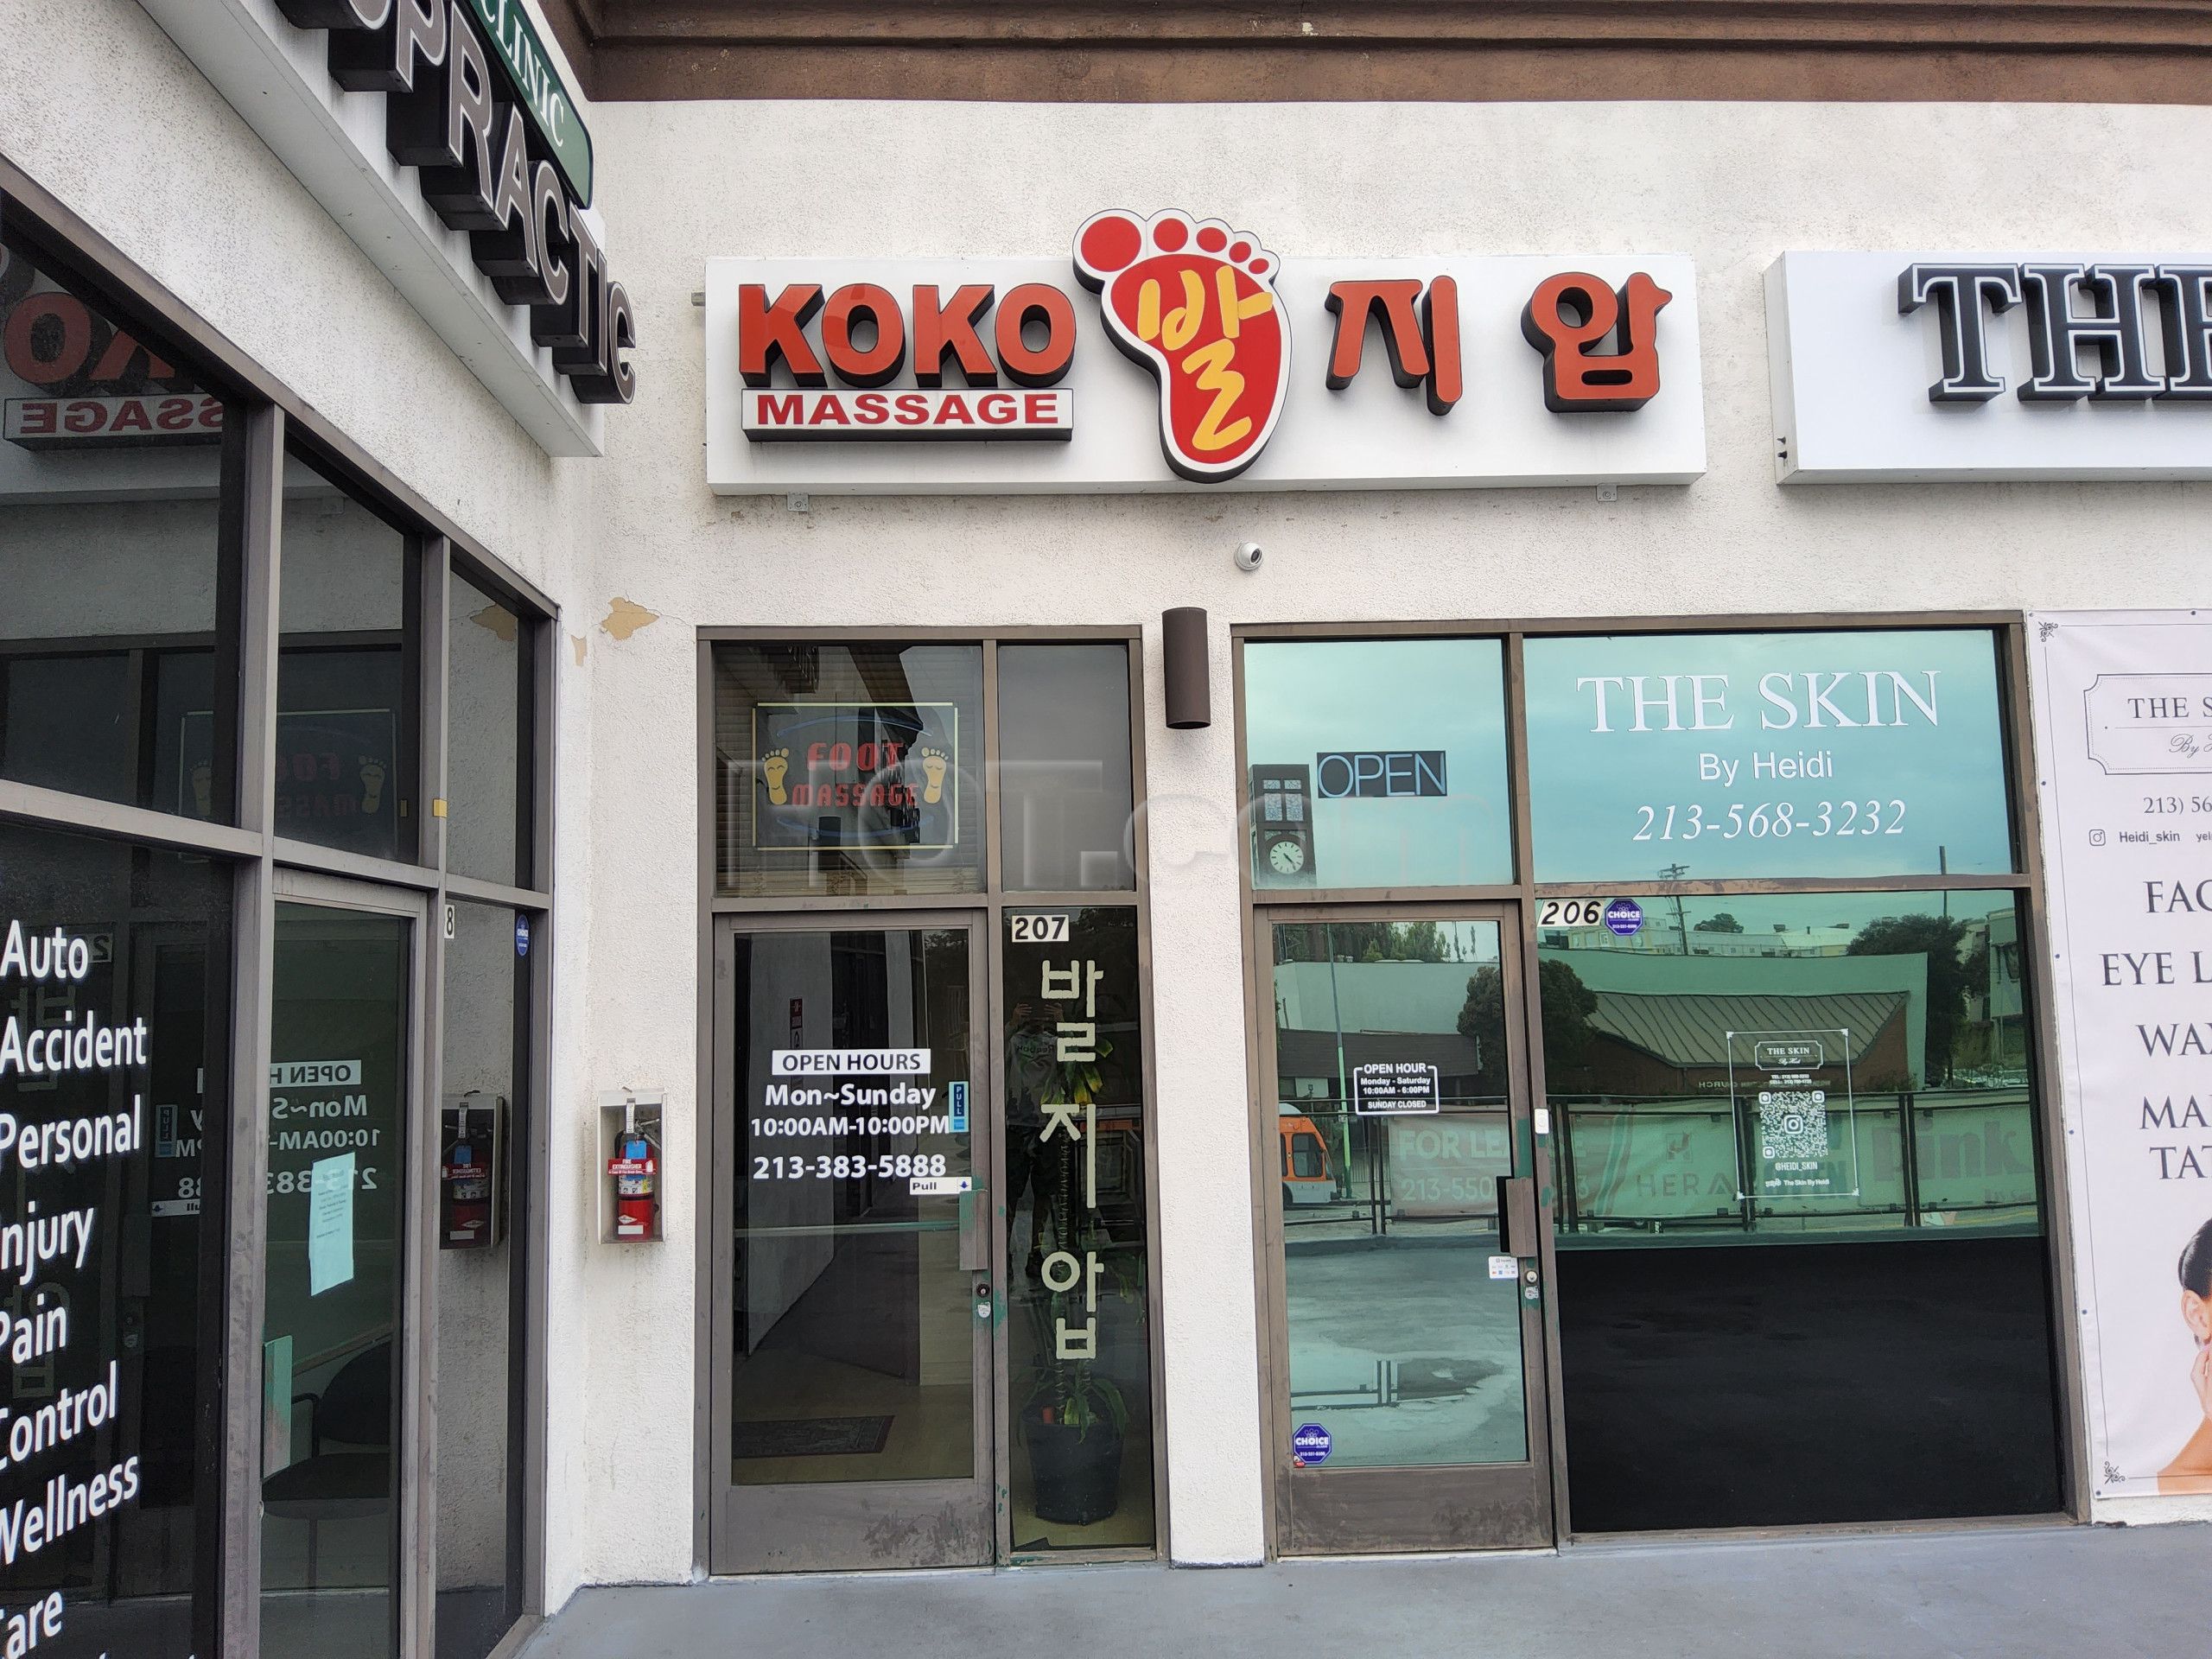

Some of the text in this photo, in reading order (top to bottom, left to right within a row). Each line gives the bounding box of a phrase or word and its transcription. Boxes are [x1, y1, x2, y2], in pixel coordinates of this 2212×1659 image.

[349, 0, 637, 406] PRACTIC
[739, 283, 1077, 384] KOKO
[1136, 264, 1274, 451] 발
[757, 393, 1058, 425] MASSAGE
[1577, 670, 1942, 733] THE SKIN
[2127, 697, 2190, 719] THE
[806, 741, 905, 772] FOOT
[2169, 733, 2199, 759] By
[1318, 753, 1446, 798] OPEN
[1699, 750, 1833, 787] By Heidi
[791, 782, 919, 808] MASSAGE
[2143, 797, 2184, 815] 213)
[1632, 799, 1907, 841] 213-568-3232
[2119, 830, 2180, 845] Heidi_skin
[1541, 900, 1602, 925] 206
[1608, 911, 1641, 919] CHOICE
[1014, 916, 1066, 941] 207
[0, 919, 89, 979] Auto
[2099, 951, 2175, 986] EYE
[0, 1010, 147, 1074] Accident
[2135, 1022, 2212, 1058] WA
[782, 1052, 922, 1071] OPEN HOURS
[1363, 1062, 1427, 1074] OPEN HOUR
[1360, 1077, 1391, 1086] Monday
[1396, 1077, 1431, 1085] Saturday
[765, 1082, 938, 1110] Mon~Sunday
[1367, 1100, 1427, 1109] SUNDAY CLOSED
[750, 1115, 950, 1137] 10:00AM-10:00PM
[2139, 1095, 2212, 1129] MA
[0, 1094, 141, 1168] Personal
[753, 1154, 947, 1179] 213-383-5888
[912, 1182, 938, 1191] Pull
[1295, 1436, 1329, 1446] CHOICE
[0, 1591, 63, 1659] are
